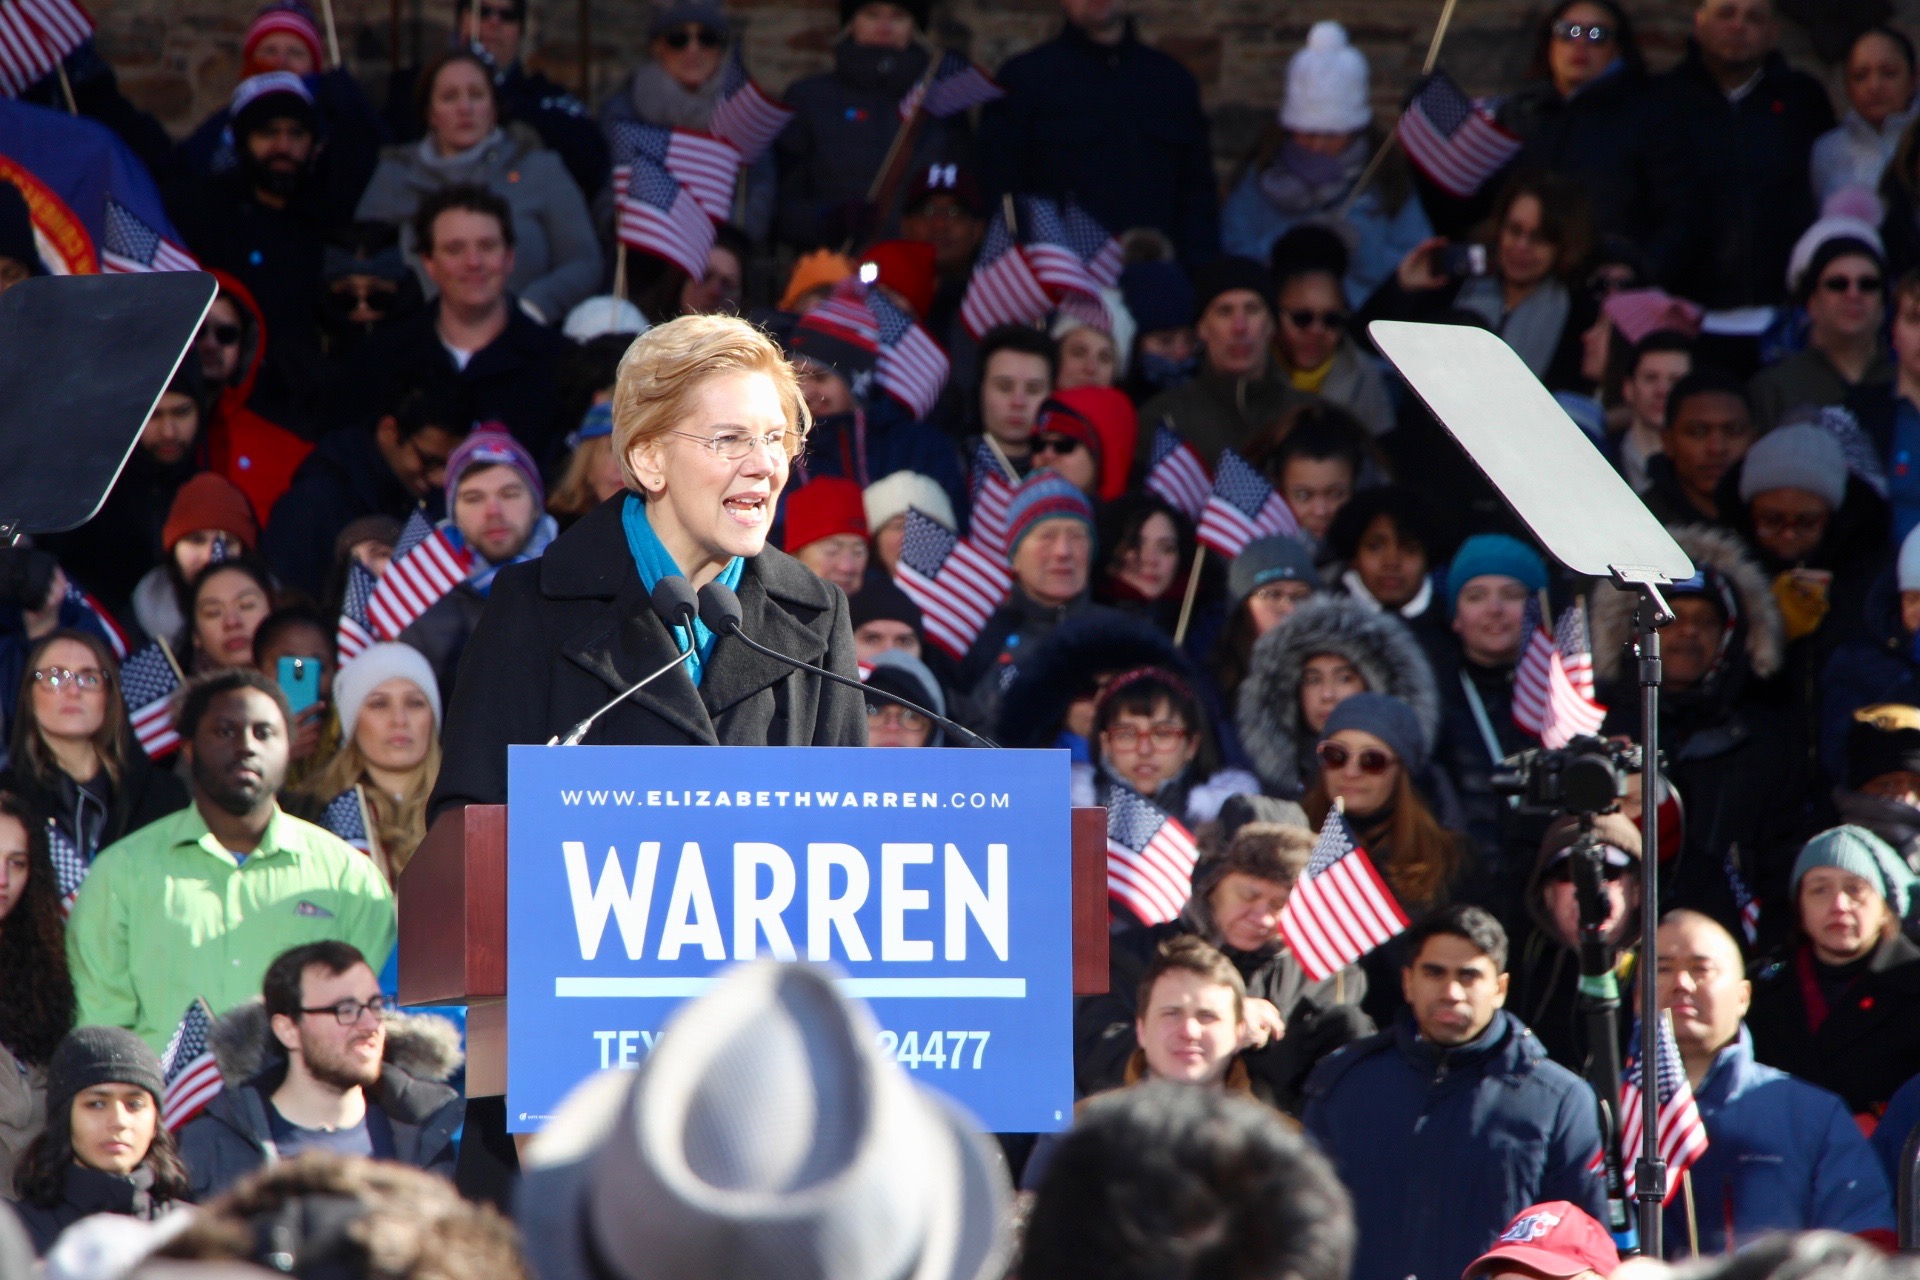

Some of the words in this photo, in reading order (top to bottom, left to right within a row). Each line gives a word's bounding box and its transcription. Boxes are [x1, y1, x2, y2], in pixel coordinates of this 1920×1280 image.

[561, 790, 1009, 808] WWW.ELIZABETHWARREN.COM
[562, 841, 1009, 962] WARREN
[875, 1030, 991, 1070] 24477
